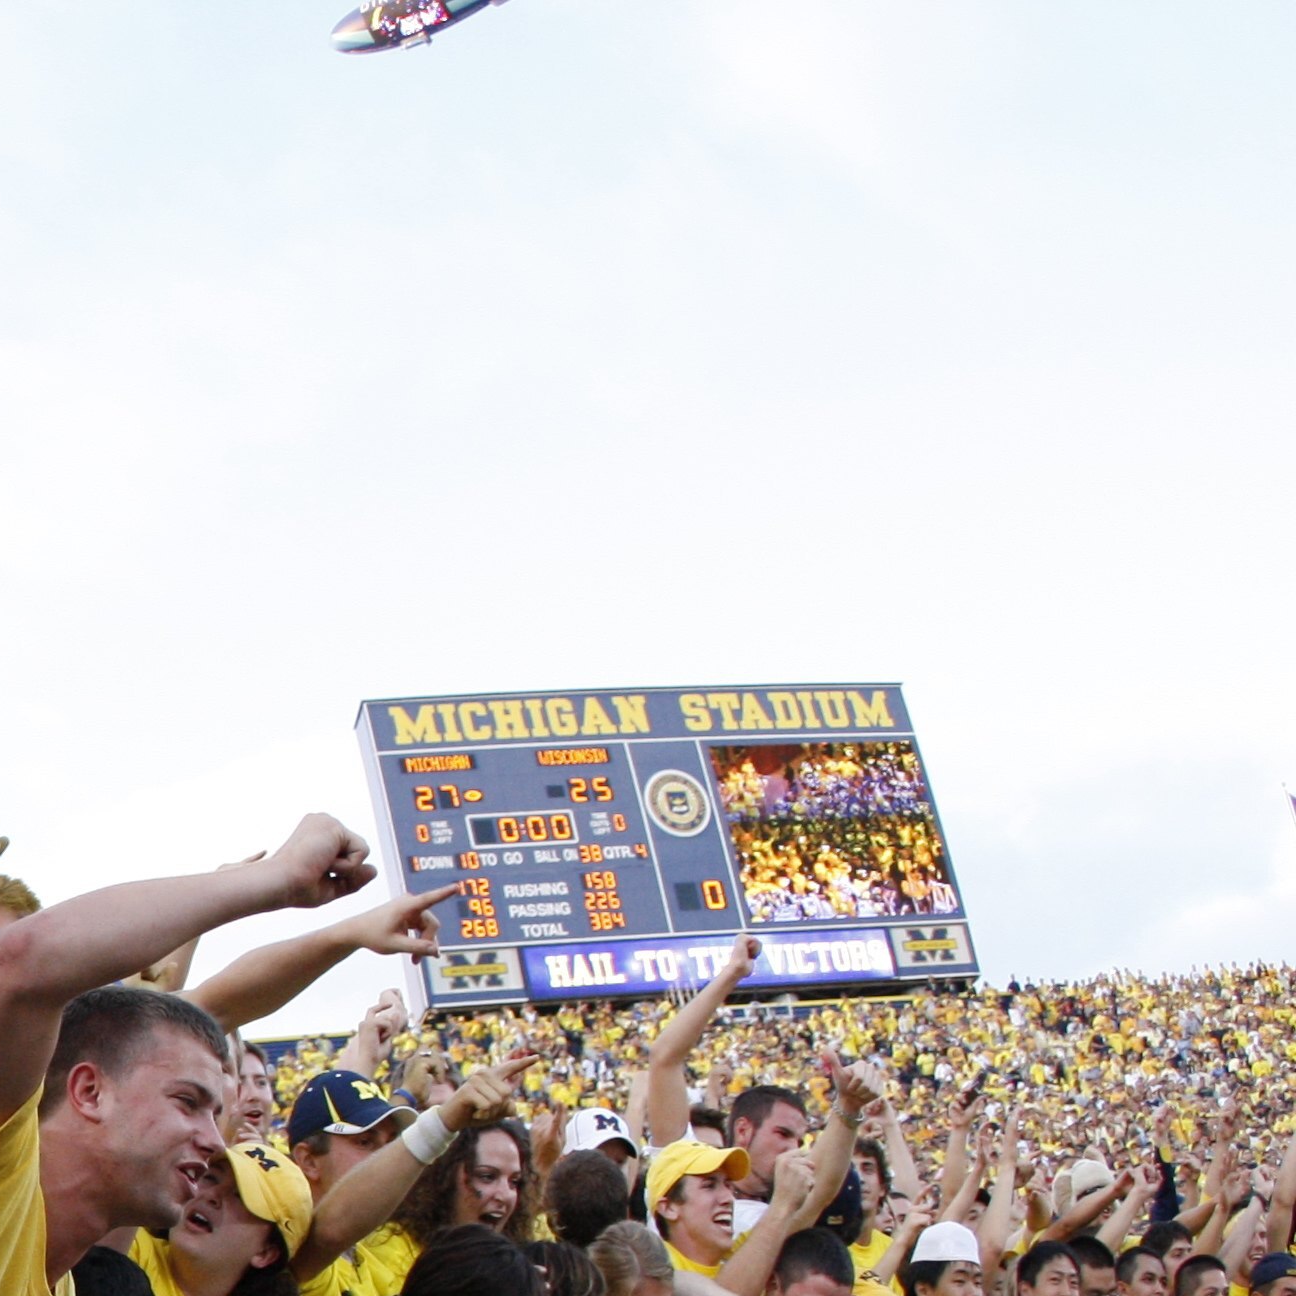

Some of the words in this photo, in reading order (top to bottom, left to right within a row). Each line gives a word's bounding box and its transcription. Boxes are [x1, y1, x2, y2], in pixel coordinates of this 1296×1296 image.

[388, 695, 651, 745] MICHIGAN
[679, 690, 895, 732] STADIUM
[404, 754, 472, 773] MICHIGAN
[537, 748, 610, 766] WISCONSIN
[414, 784, 461, 811] 27
[568, 776, 613, 802] 25
[416, 824, 429, 843] 0
[498, 814, 571, 843] 0:00
[612, 813, 626, 832] 0
[460, 851, 481, 870] 10
[480, 852, 498, 867] TO
[503, 851, 524, 865] GO
[534, 849, 561, 863] BALL
[634, 843, 648, 858] 4
[458, 877, 491, 897] 172
[503, 881, 569, 898] RUSHING
[584, 871, 617, 890] 158
[468, 898, 496, 917] 96
[509, 901, 572, 918] PASSING
[584, 891, 621, 911] 226
[460, 918, 500, 939] 268
[520, 922, 570, 938] TOTAL
[589, 911, 626, 931] 384
[545, 952, 627, 988] HAIL
[634, 949, 679, 982] TO
[688, 945, 736, 981] TH
[762, 940, 888, 975] VICTORS
[593, 1113, 621, 1133] M
